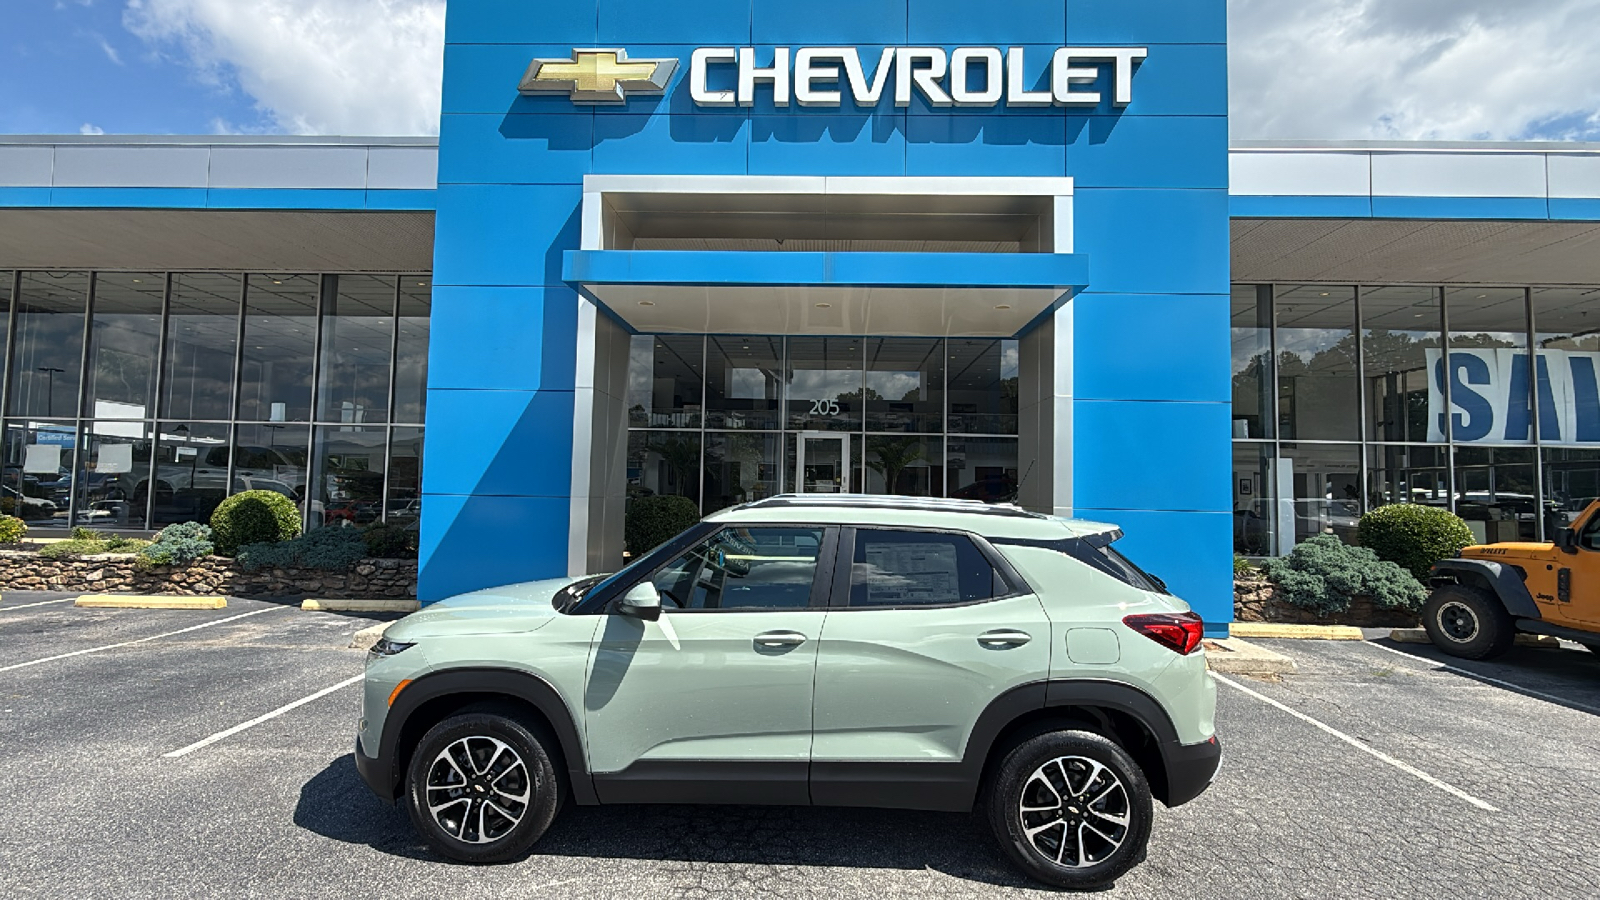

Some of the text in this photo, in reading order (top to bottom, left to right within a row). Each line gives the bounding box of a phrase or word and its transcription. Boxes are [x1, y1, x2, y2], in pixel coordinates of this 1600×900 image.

[690, 46, 1149, 108] CHEVROLET
[809, 399, 840, 416] 205
[1536, 592, 1554, 602] Jeep
